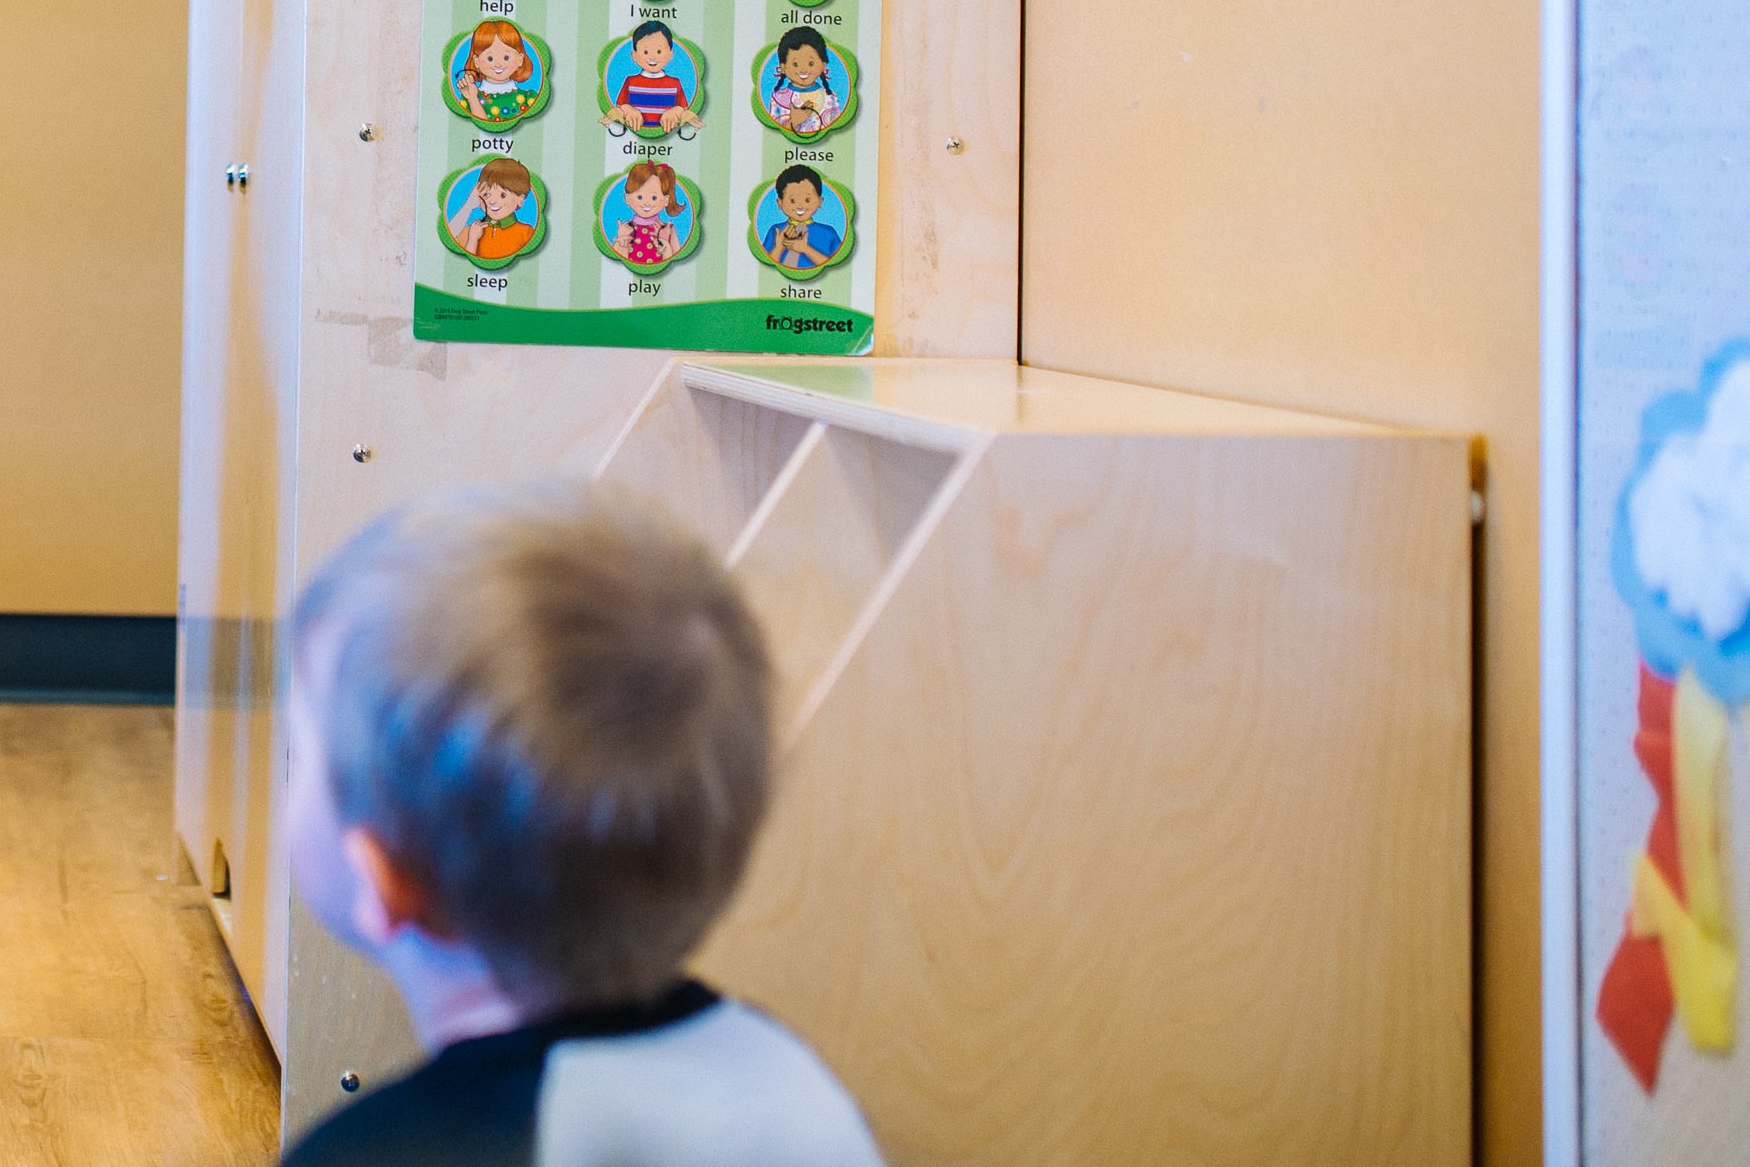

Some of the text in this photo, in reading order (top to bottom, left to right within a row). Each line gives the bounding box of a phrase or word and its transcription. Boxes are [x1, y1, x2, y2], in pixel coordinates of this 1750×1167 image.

[630, 4, 678, 19] I want
[780, 9, 843, 26] all done
[471, 136, 514, 155] potty
[622, 141, 673, 159] diaper
[784, 146, 834, 164] please
[466, 273, 508, 292] sleep
[628, 278, 661, 297] play
[780, 284, 822, 299] share
[765, 314, 854, 334] frogstreet
